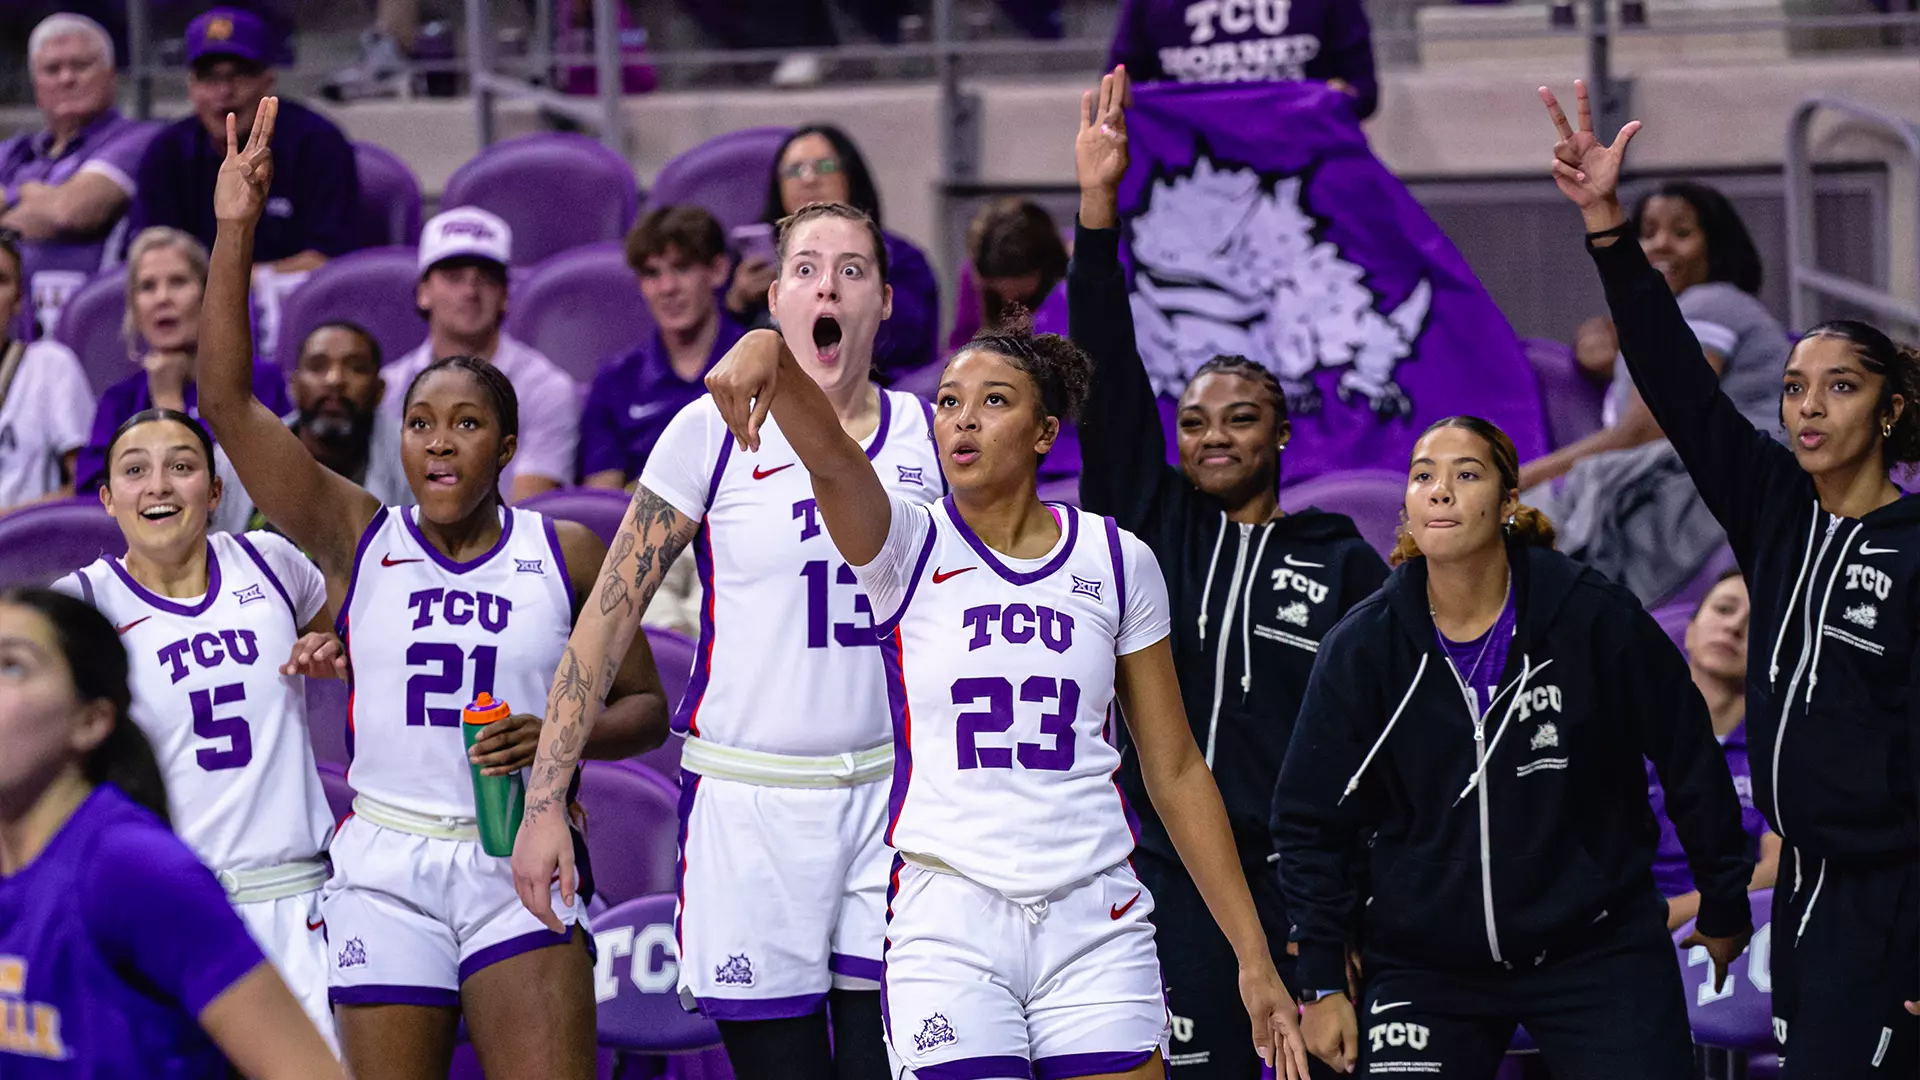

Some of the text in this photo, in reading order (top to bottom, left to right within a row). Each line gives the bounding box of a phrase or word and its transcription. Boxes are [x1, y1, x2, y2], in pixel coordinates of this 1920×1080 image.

[1185, 0, 1291, 43] TCU
[799, 560, 879, 648] 13
[1271, 568, 1329, 604] TCU
[1845, 564, 1893, 601] TCU
[408, 587, 513, 634] TCU
[962, 603, 1075, 654] TCU
[157, 630, 259, 685] TCU
[406, 642, 497, 728] 21
[1512, 684, 1562, 722] TCU
[189, 682, 252, 772] 5
[951, 675, 1081, 771] 23
[594, 923, 680, 1004] TC
[1368, 1022, 1430, 1053] TCU
